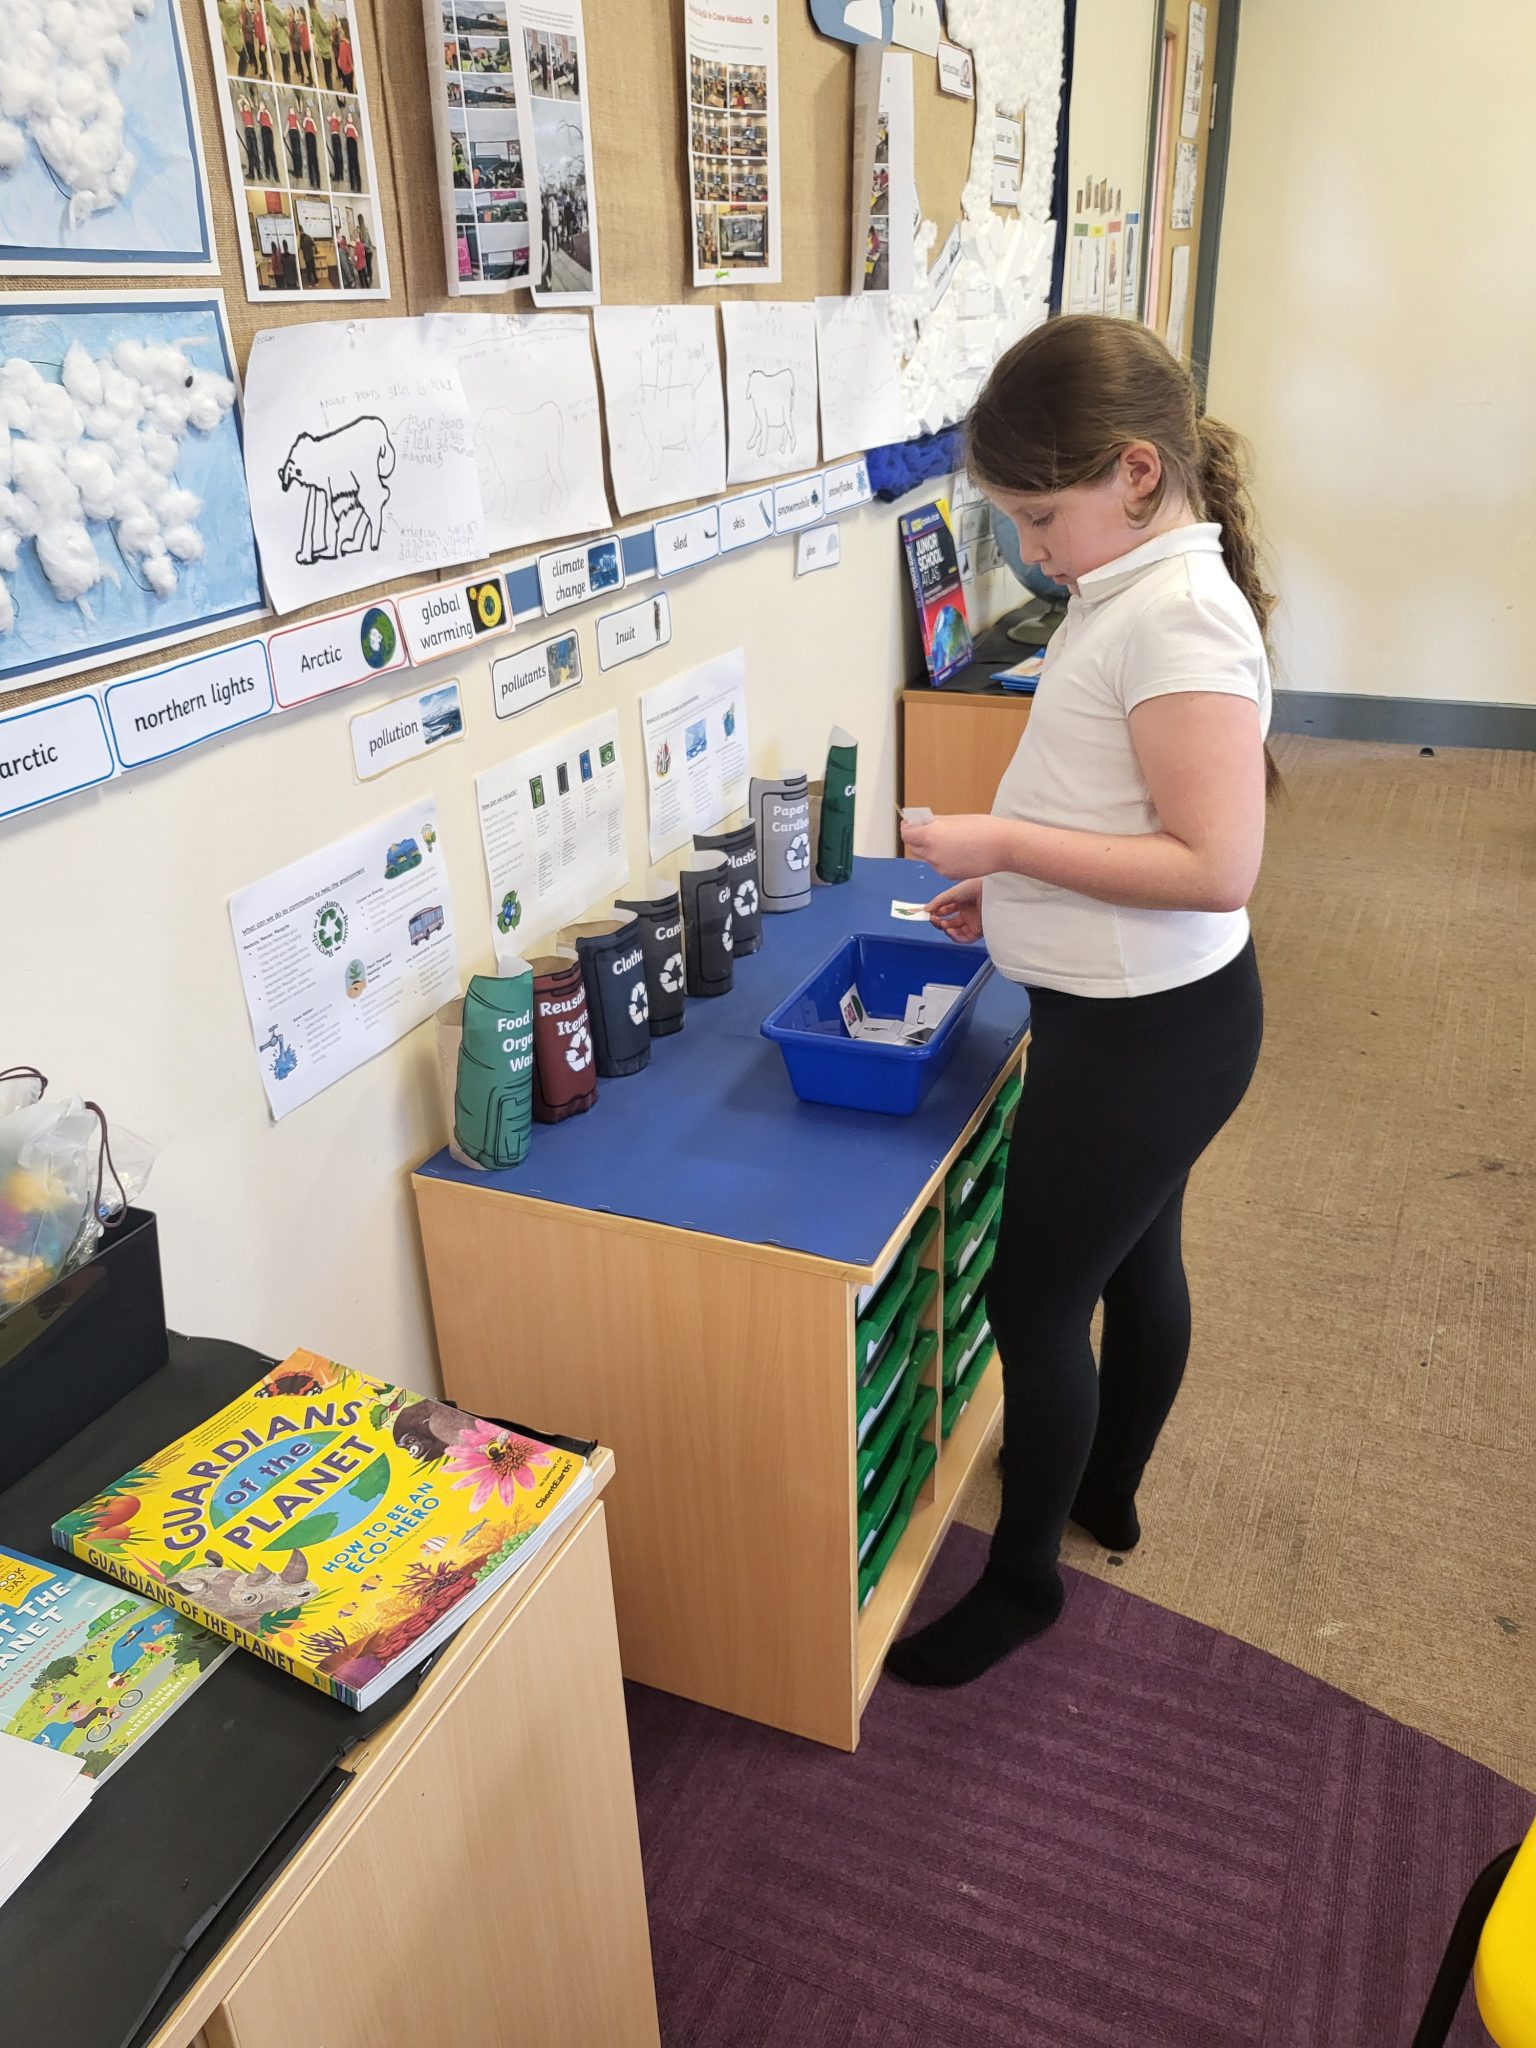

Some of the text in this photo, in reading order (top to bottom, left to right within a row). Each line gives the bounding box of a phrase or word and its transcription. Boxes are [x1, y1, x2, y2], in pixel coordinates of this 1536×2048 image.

[777, 498, 811, 516] snowmobile
[732, 517, 746, 530] skis
[673, 534, 688, 551] sled
[916, 532, 938, 557] JUNIOR
[552, 556, 585, 578] climate
[918, 548, 945, 572] SCHOOL
[921, 566, 942, 587] ATLAS
[556, 580, 587, 602] change
[421, 594, 461, 622] global
[420, 620, 473, 650] warming
[615, 628, 636, 646] Inuit
[301, 646, 343, 673] Arctic
[501, 664, 547, 699] pollutants
[134, 674, 255, 732] northern lights
[369, 718, 419, 756] pollution
[773, 804, 804, 818] Paper
[497, 1009, 530, 1032] Food
[556, 1008, 588, 1036] Items
[162, 1400, 364, 1551] GUARDIANS
[224, 1441, 312, 1506] of the
[535, 1463, 572, 1509] ClientEarth
[222, 1434, 376, 1550] PLANET
[322, 1539, 366, 1575] HOW
[364, 1522, 388, 1540] TO
[386, 1504, 410, 1522] BE
[408, 1482, 434, 1502] AN
[345, 1496, 440, 1575] ECO-HERO
[4, 1574, 28, 1593] DAY
[15, 1581, 72, 1617] THE
[88, 1548, 295, 1674] GUARDIANS OF THE PLANET
[28, 1652, 52, 1674] change
